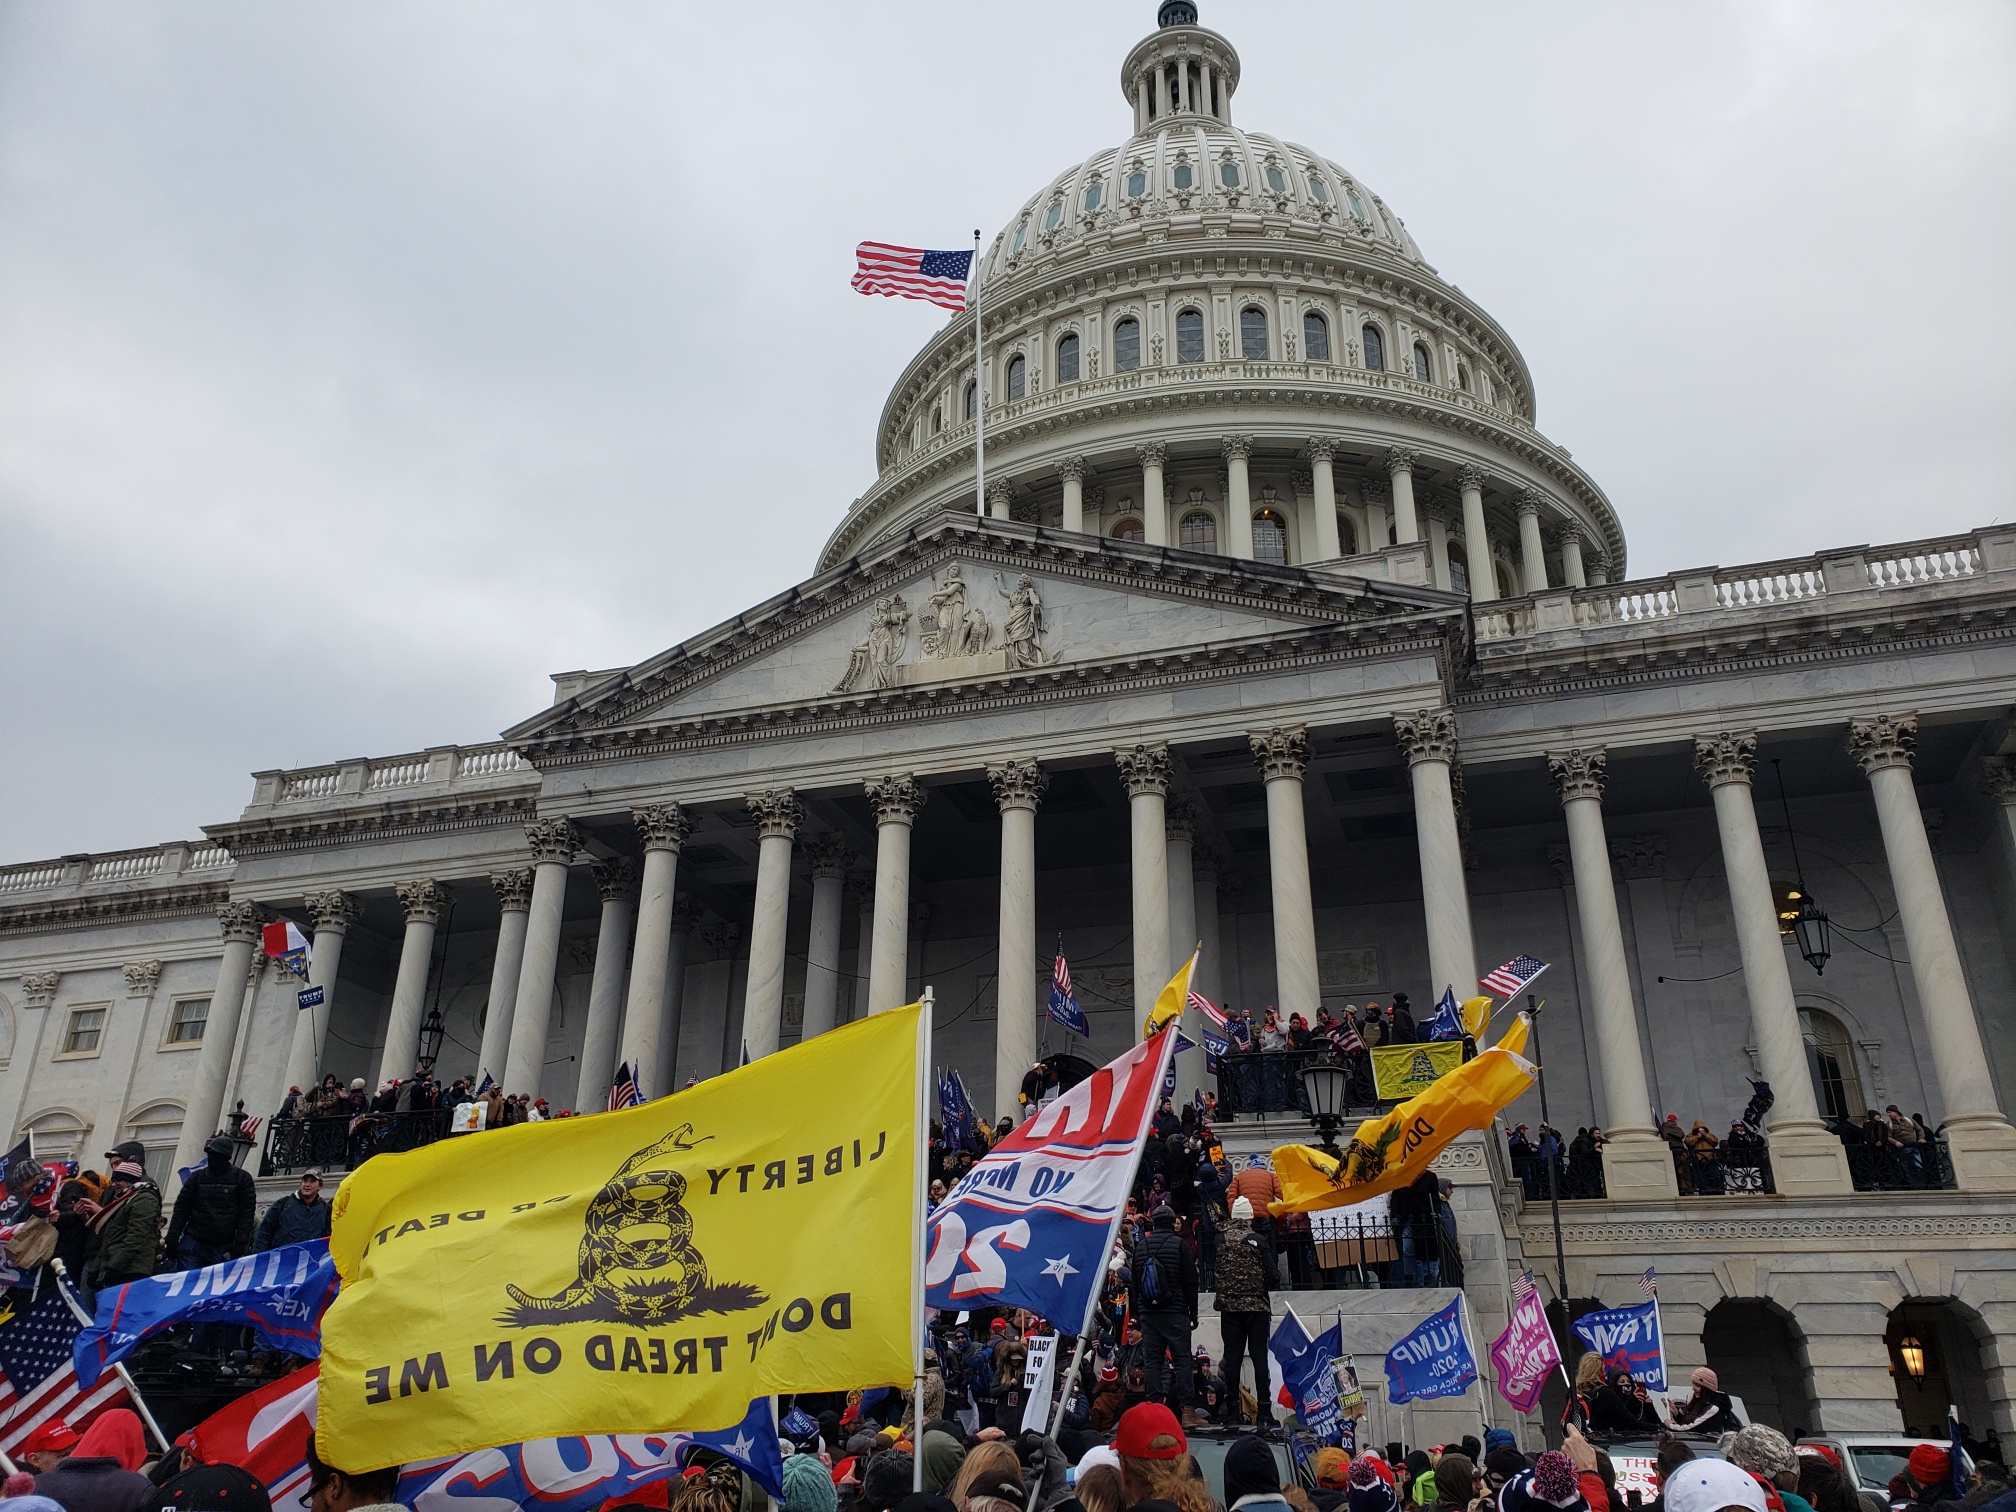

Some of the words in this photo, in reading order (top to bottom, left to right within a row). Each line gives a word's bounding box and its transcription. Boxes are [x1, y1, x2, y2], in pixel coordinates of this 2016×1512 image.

[299, 990, 323, 1000] TRUMP
[1032, 1356, 1046, 1368] FO
[1617, 1487, 1657, 1498] OAX
